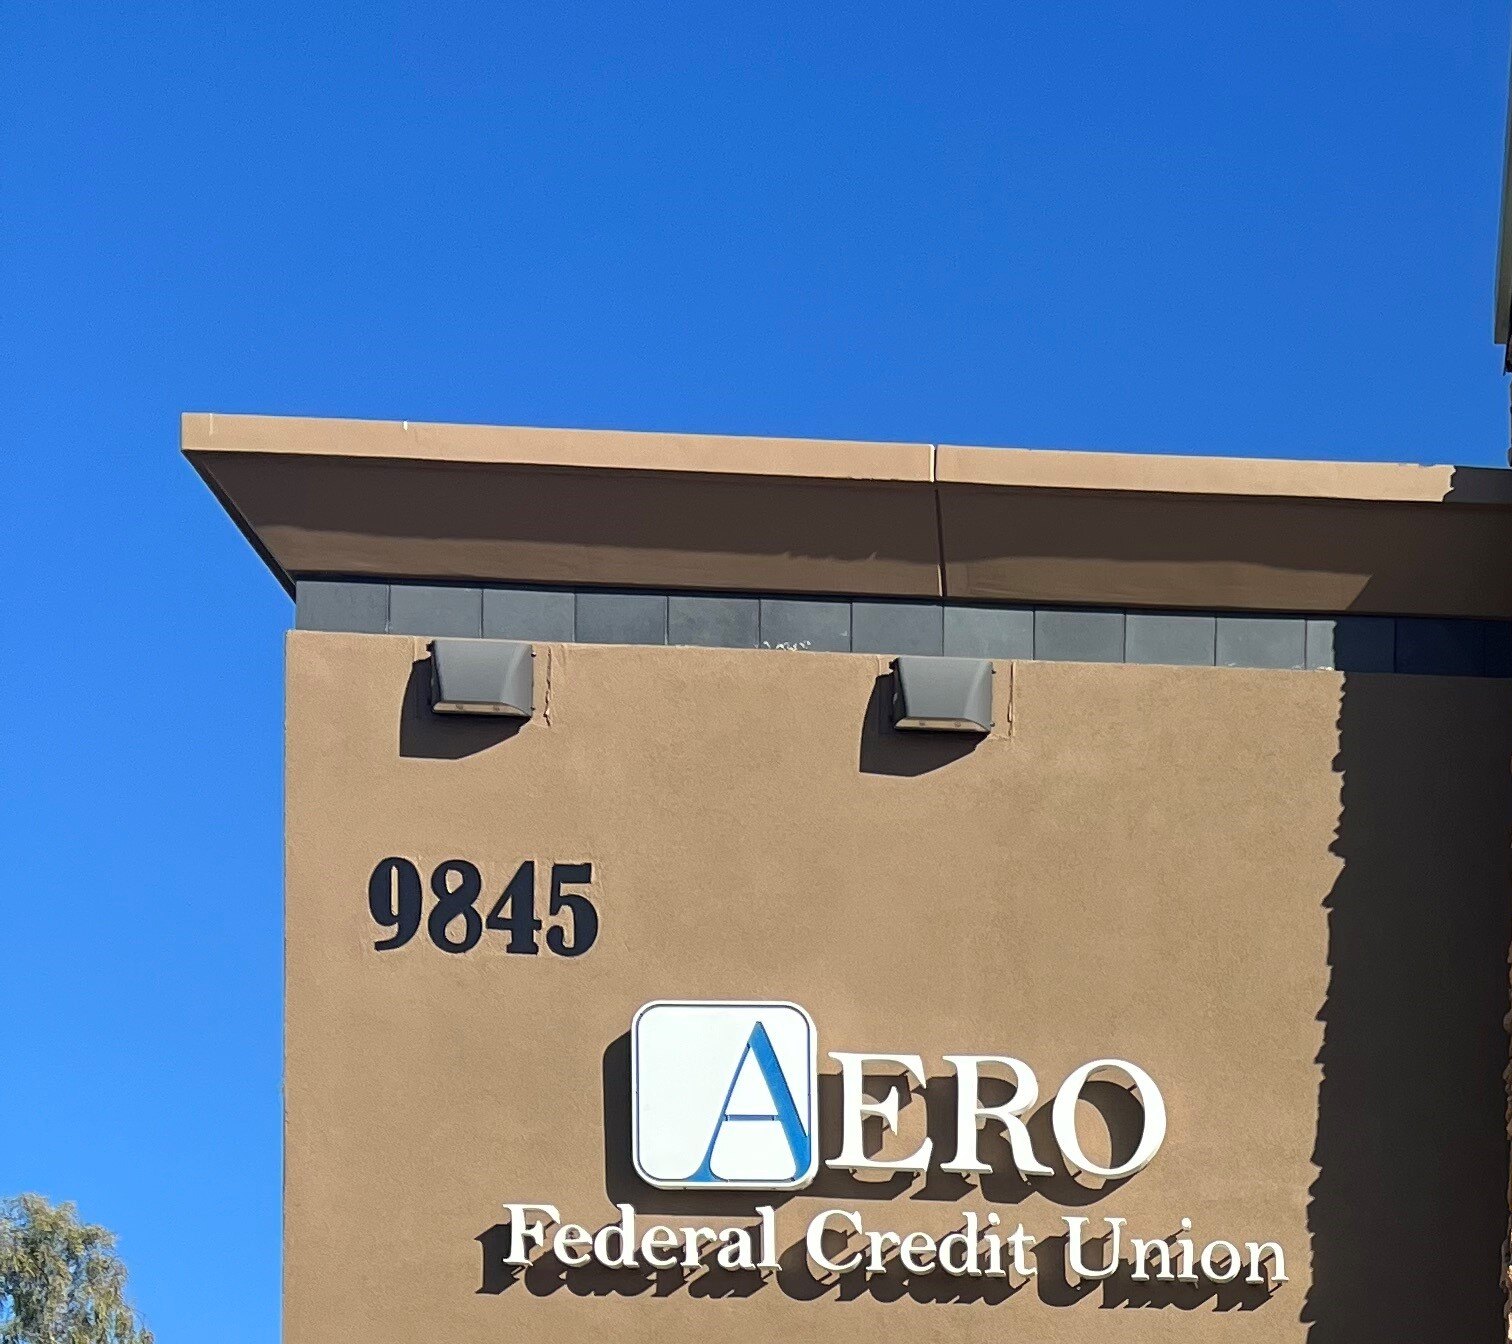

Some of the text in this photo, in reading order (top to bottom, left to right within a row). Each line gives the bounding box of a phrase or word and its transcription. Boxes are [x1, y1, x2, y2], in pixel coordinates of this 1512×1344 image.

[368, 856, 599, 958] 9845
[684, 1020, 1168, 1183] AERO
[502, 1203, 1290, 1285] Federal Credit Union
